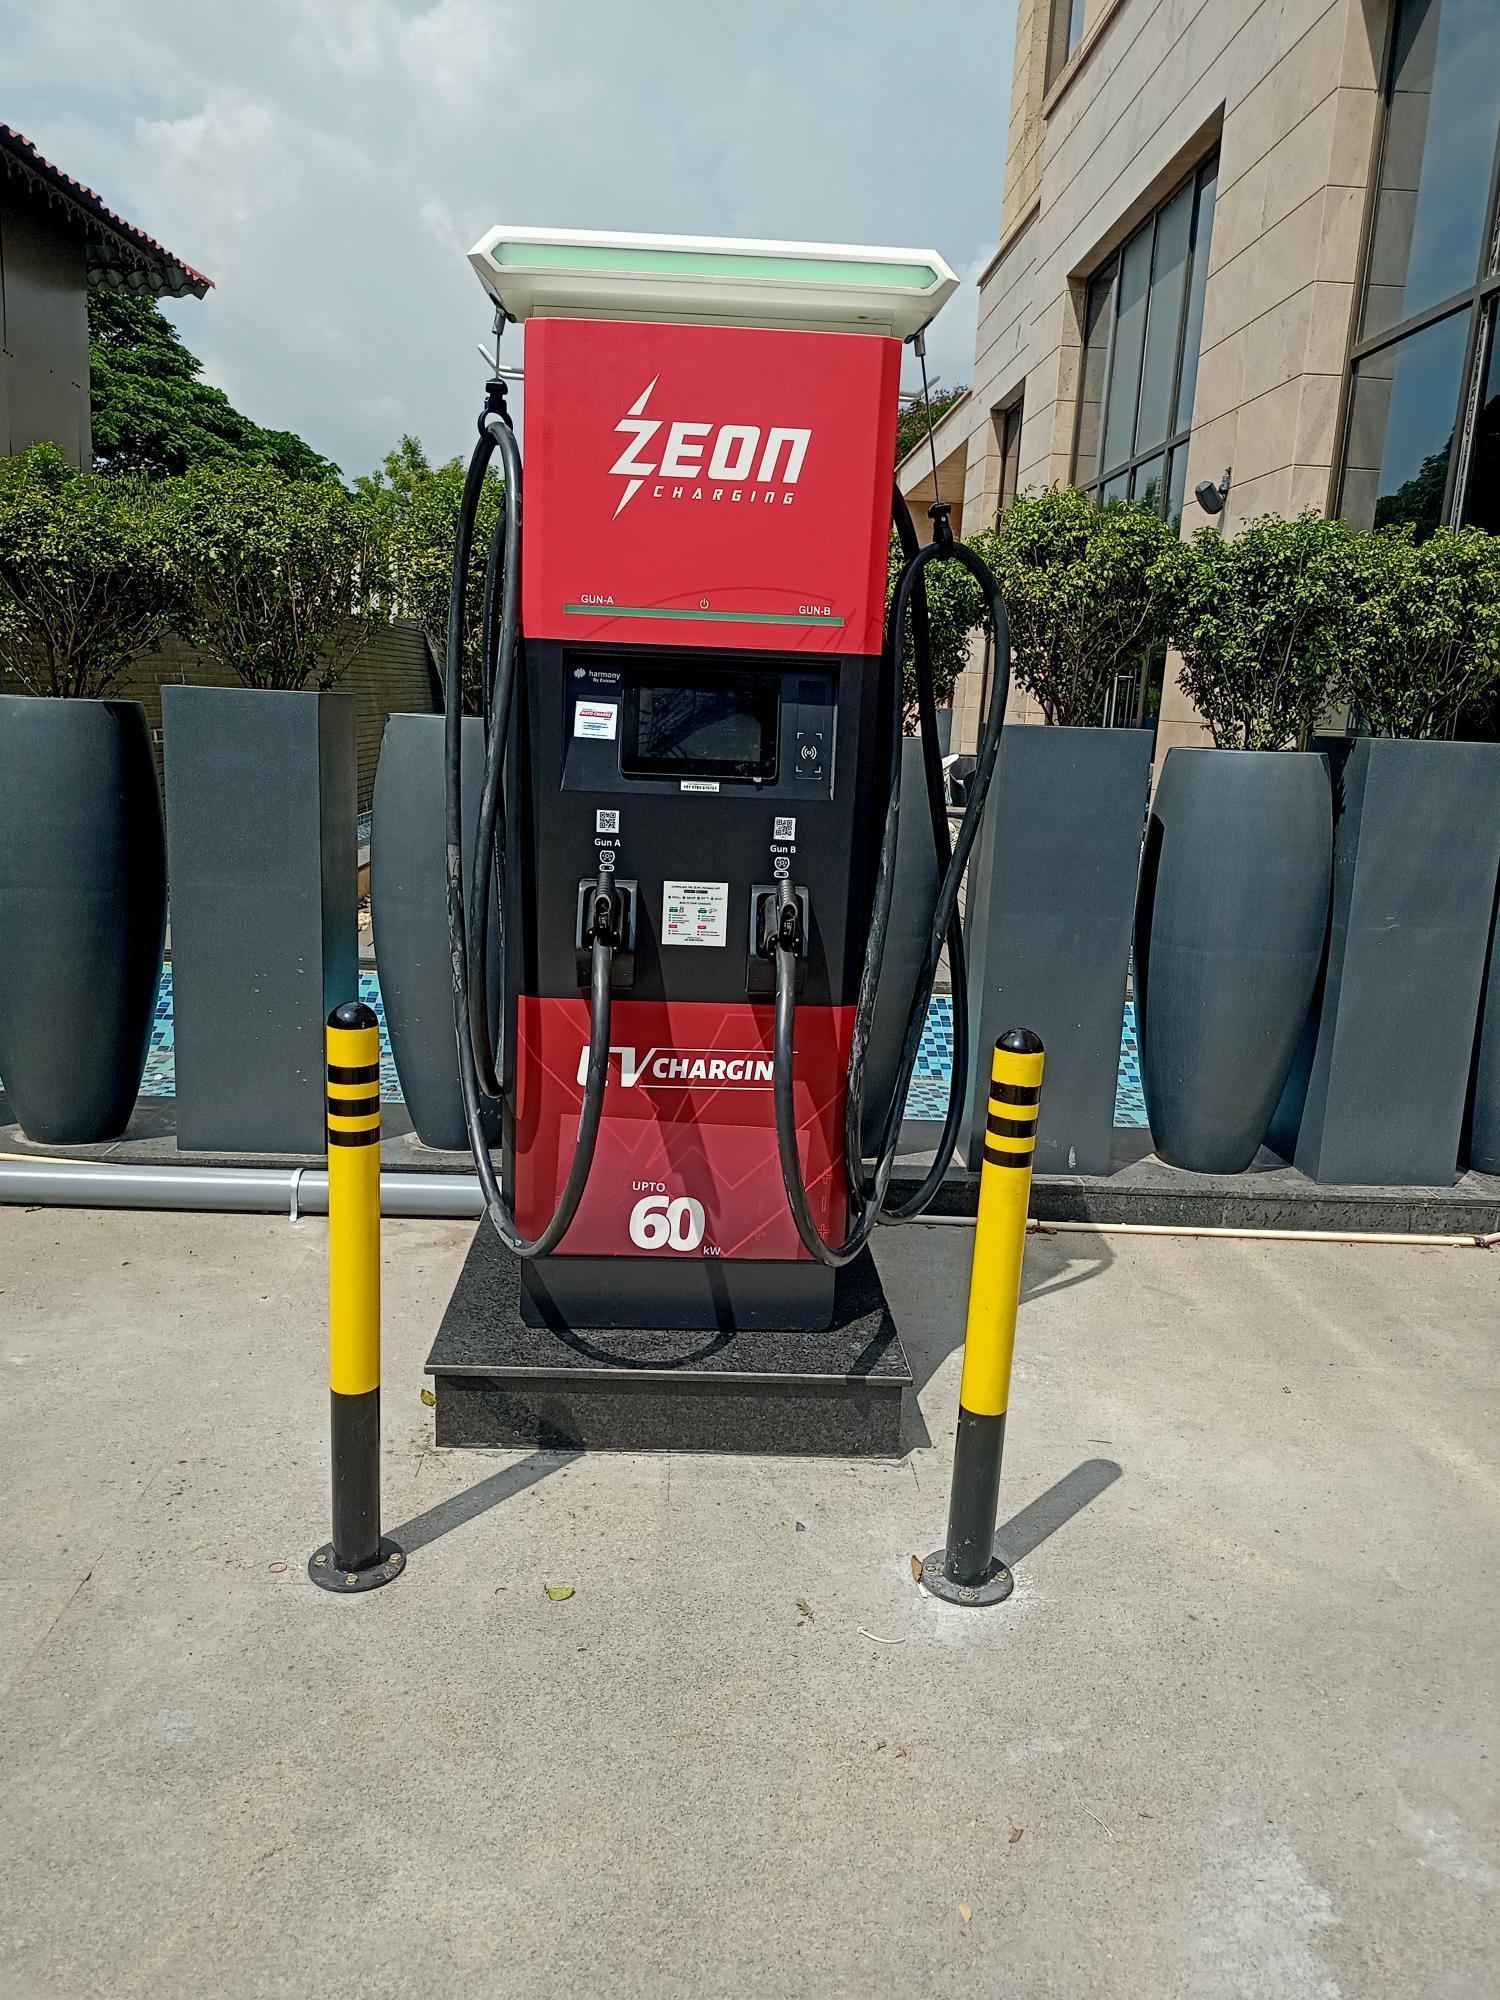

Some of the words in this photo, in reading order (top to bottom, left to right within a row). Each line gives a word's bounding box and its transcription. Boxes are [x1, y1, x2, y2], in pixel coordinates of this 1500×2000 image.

[608, 418, 813, 484] ZEON
[653, 485, 795, 504] CHARGING
[580, 594, 615, 605] GUN-A
[798, 605, 832, 616] GUN-B
[588, 669, 621, 681] harmony
[594, 838, 612, 846] Gun
[614, 839, 621, 847] A
[770, 844, 788, 853] Gun
[790, 845, 797, 853] B
[652, 1057, 775, 1081] CHARGIN
[632, 1180, 666, 1192] UPTO
[629, 1195, 706, 1252] 60
[703, 1244, 722, 1256] kW
